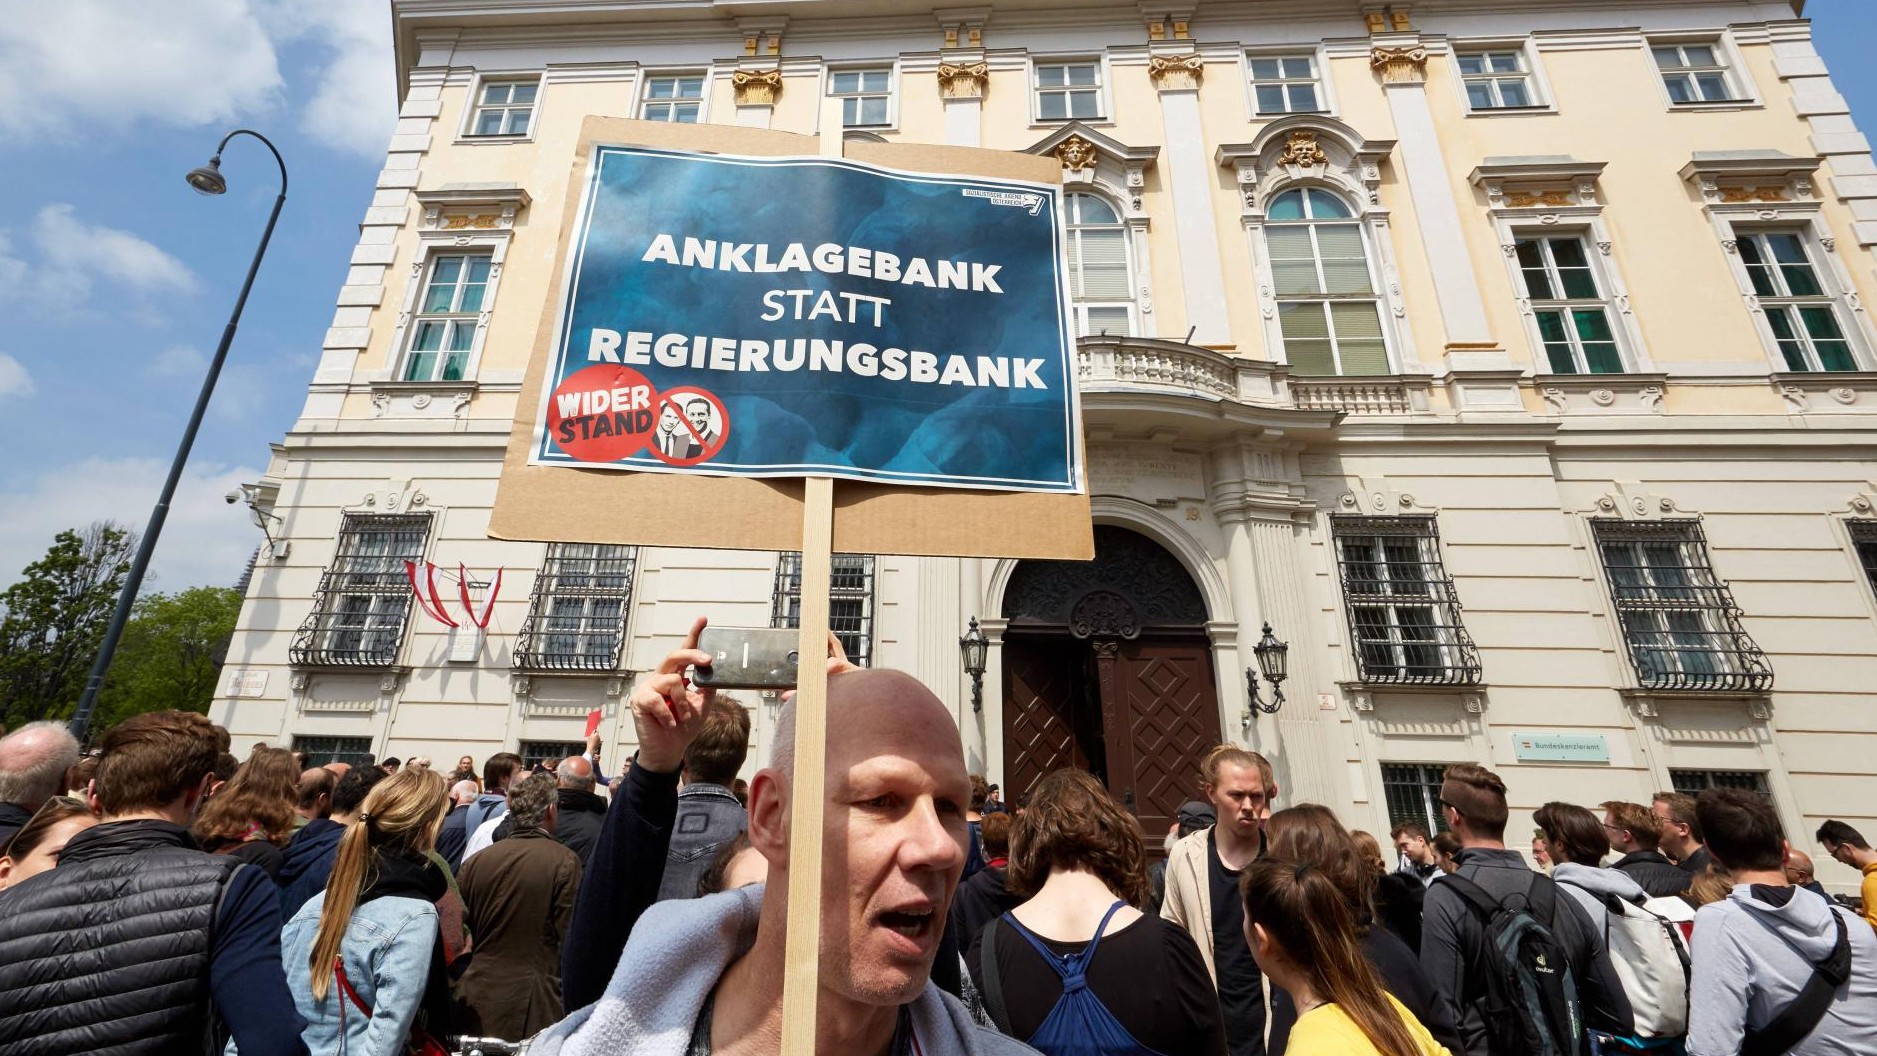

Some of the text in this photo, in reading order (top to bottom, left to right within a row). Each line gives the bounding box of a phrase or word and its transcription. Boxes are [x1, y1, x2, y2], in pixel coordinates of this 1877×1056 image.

[642, 234, 1004, 294] ANKLAGEBANK
[760, 289, 891, 328] STATT
[588, 328, 1048, 390] REGIERUNGSBANK
[557, 385, 651, 419] WIDER
[559, 410, 653, 444] STAND
[1534, 742, 1600, 750] Bundeskanzleramt
